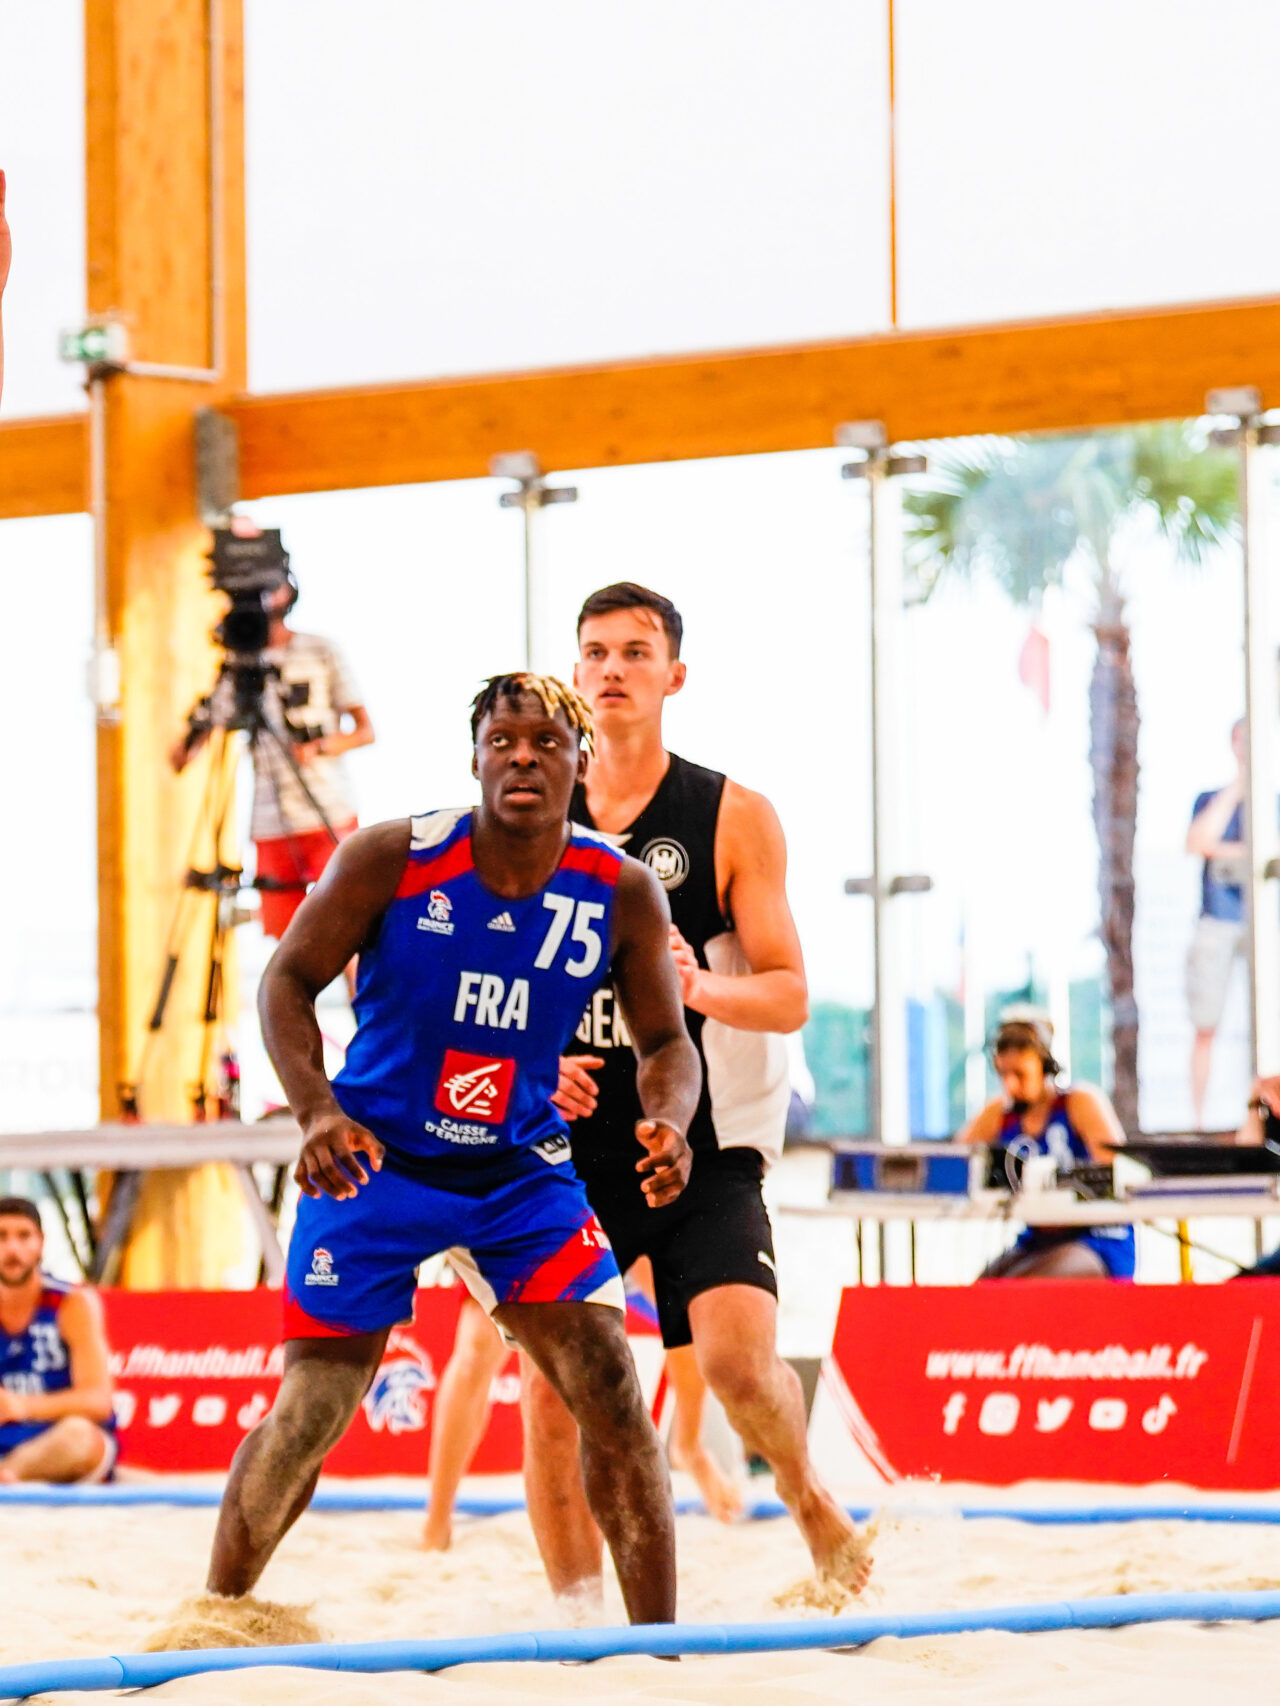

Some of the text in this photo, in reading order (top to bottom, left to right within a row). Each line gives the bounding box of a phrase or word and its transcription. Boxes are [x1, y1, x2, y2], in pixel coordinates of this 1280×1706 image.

[533, 892, 606, 978] 75
[453, 969, 530, 1031] FRA
[440, 1118, 489, 1137] CAISSE
[925, 1343, 1208, 1379] www.ffhandball.fr
